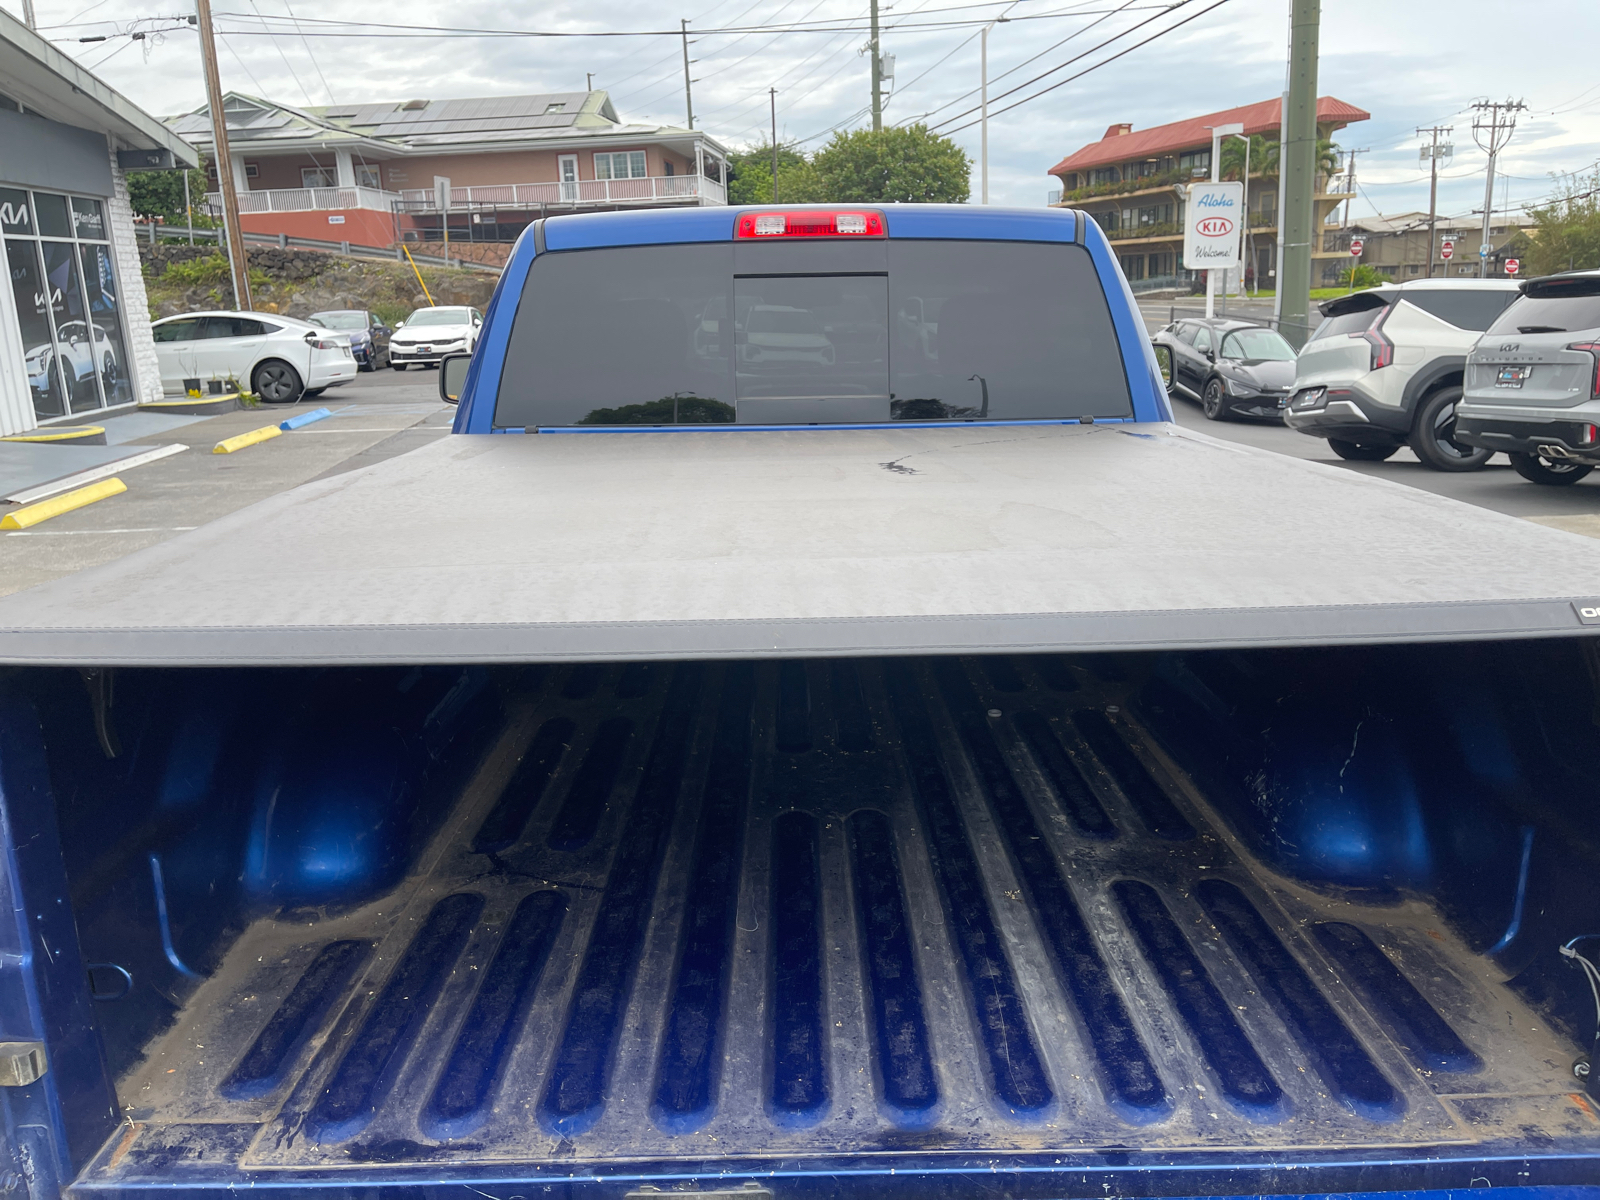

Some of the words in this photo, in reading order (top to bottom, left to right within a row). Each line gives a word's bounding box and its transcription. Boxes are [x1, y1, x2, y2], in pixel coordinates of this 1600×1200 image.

[1197, 193, 1234, 208] Aloha
[1203, 221, 1228, 232] KIA
[1195, 245, 1233, 259] Welcome!
